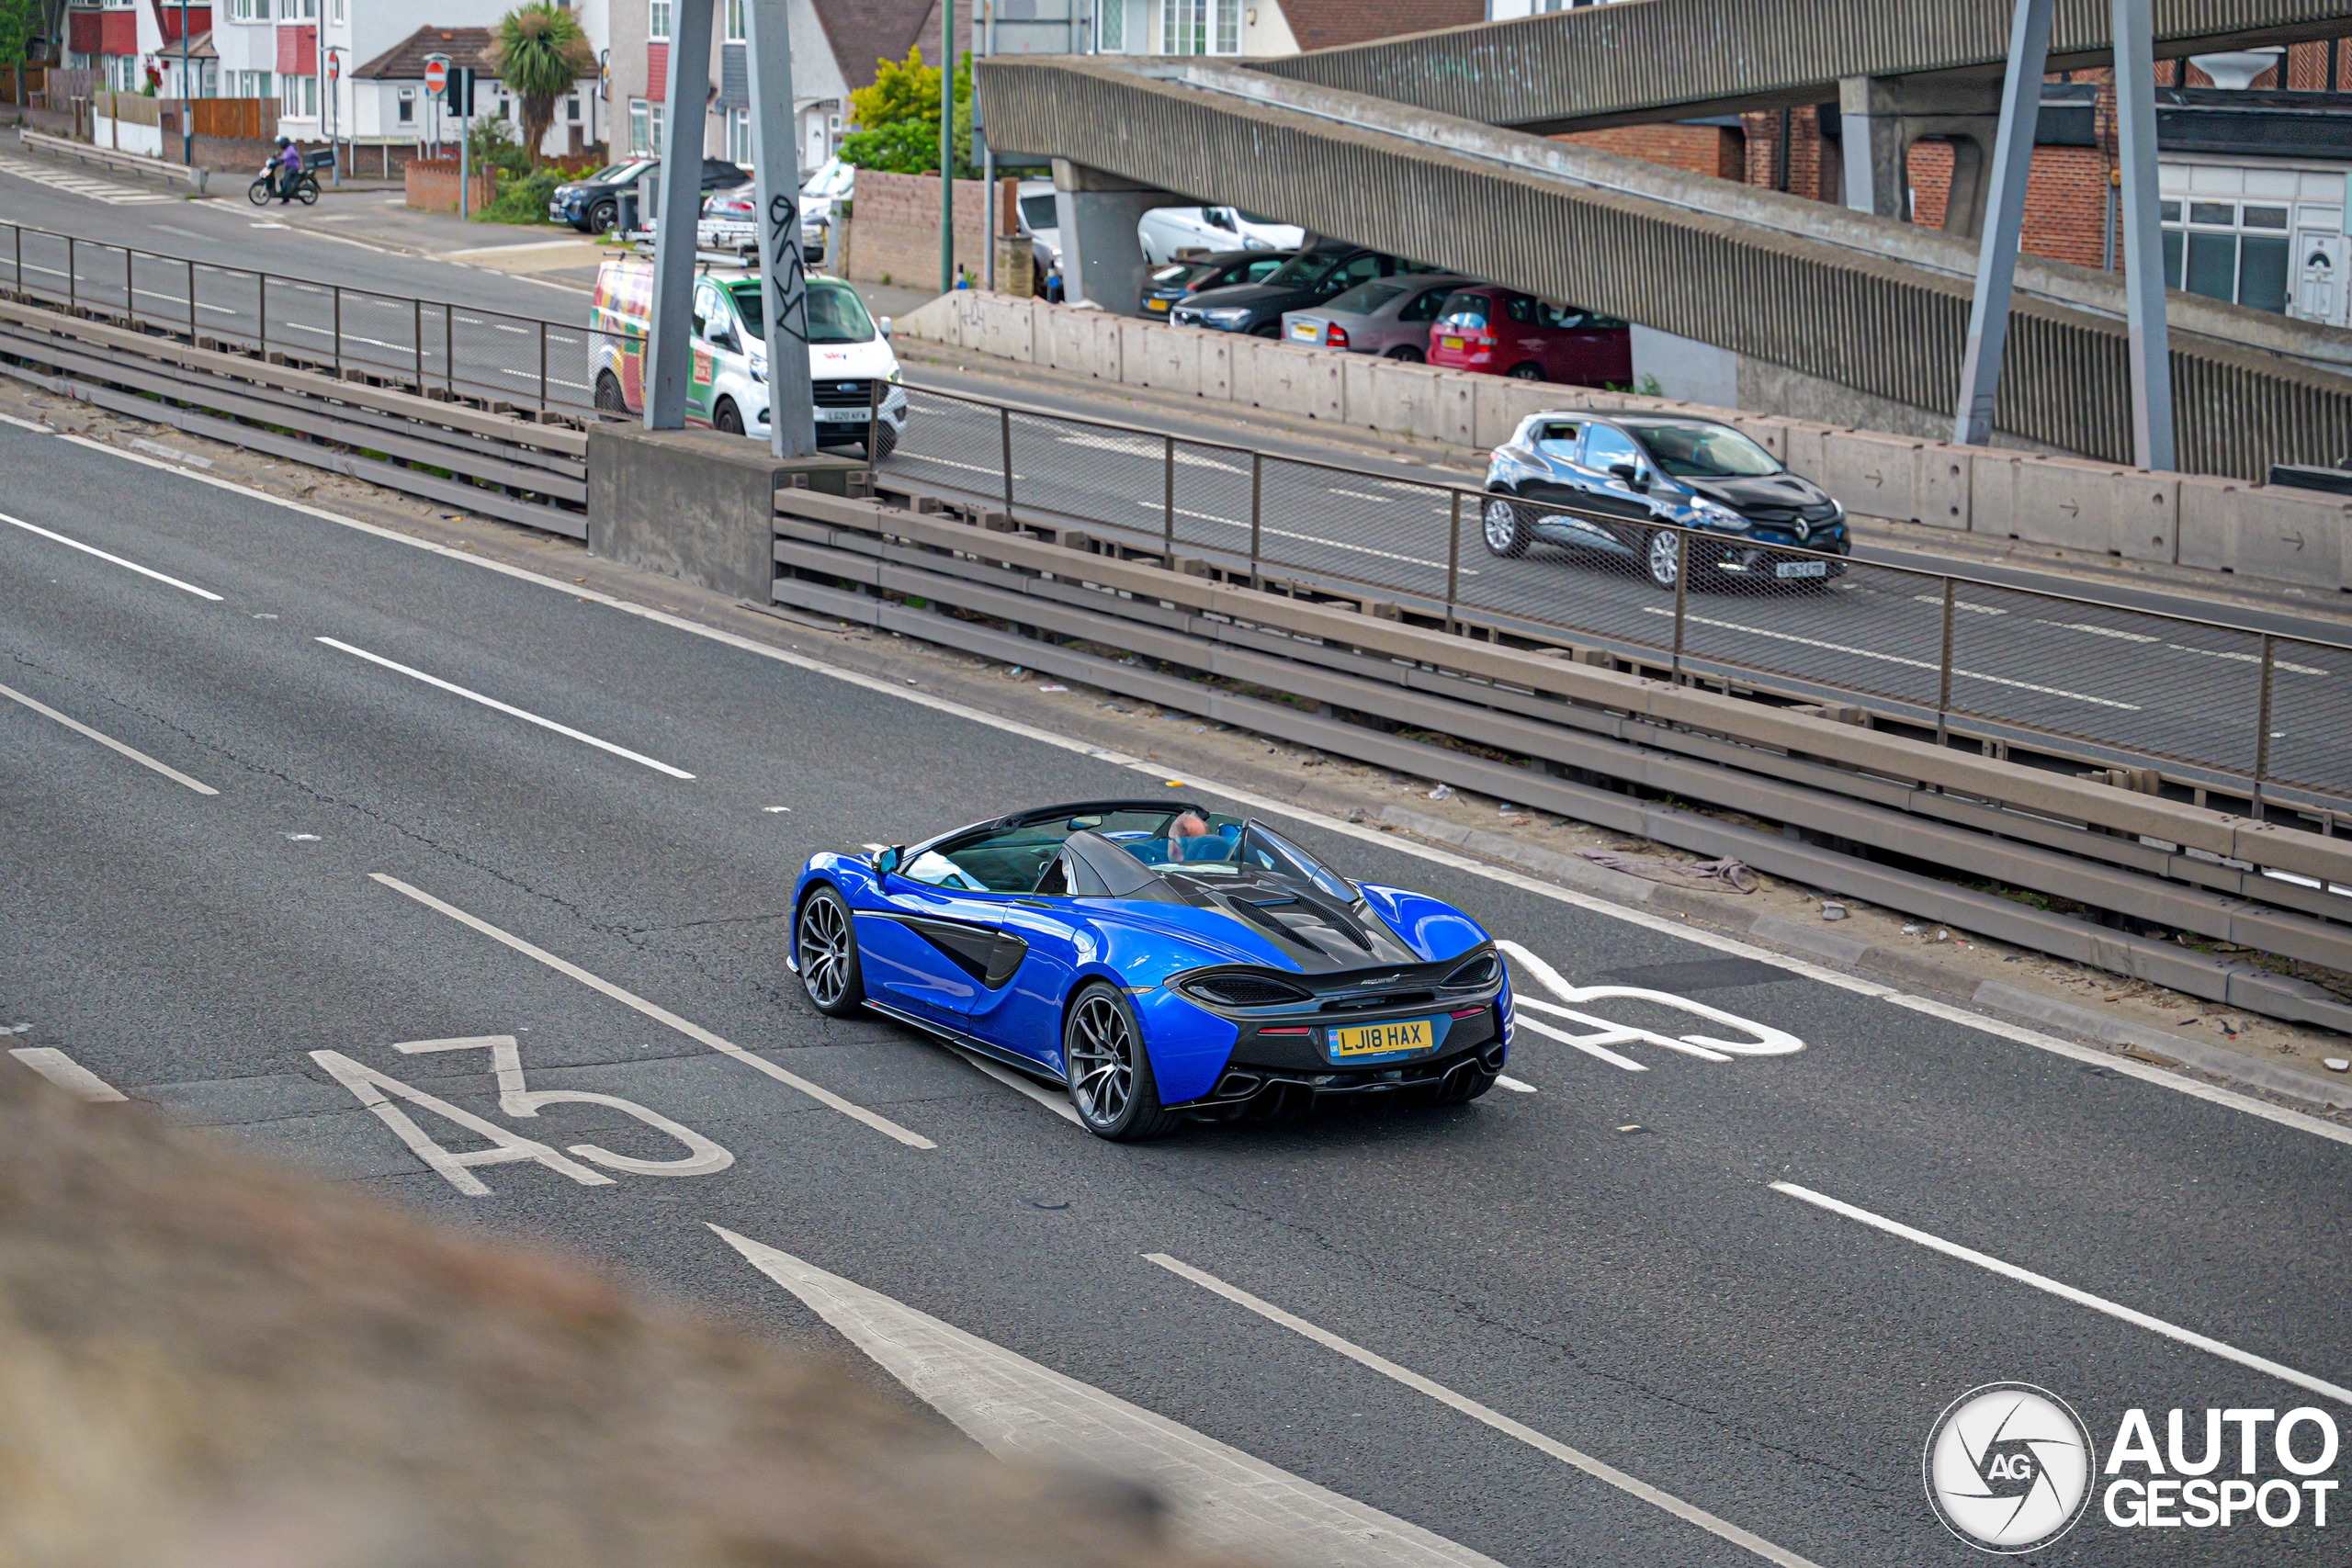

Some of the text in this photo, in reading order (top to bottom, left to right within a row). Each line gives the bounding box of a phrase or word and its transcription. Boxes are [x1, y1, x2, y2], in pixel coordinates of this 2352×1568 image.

[1360, 975, 1398, 986] McLaren
[1340, 1024, 1422, 1051] LJ18 HAX
[308, 1034, 735, 1195] A3
